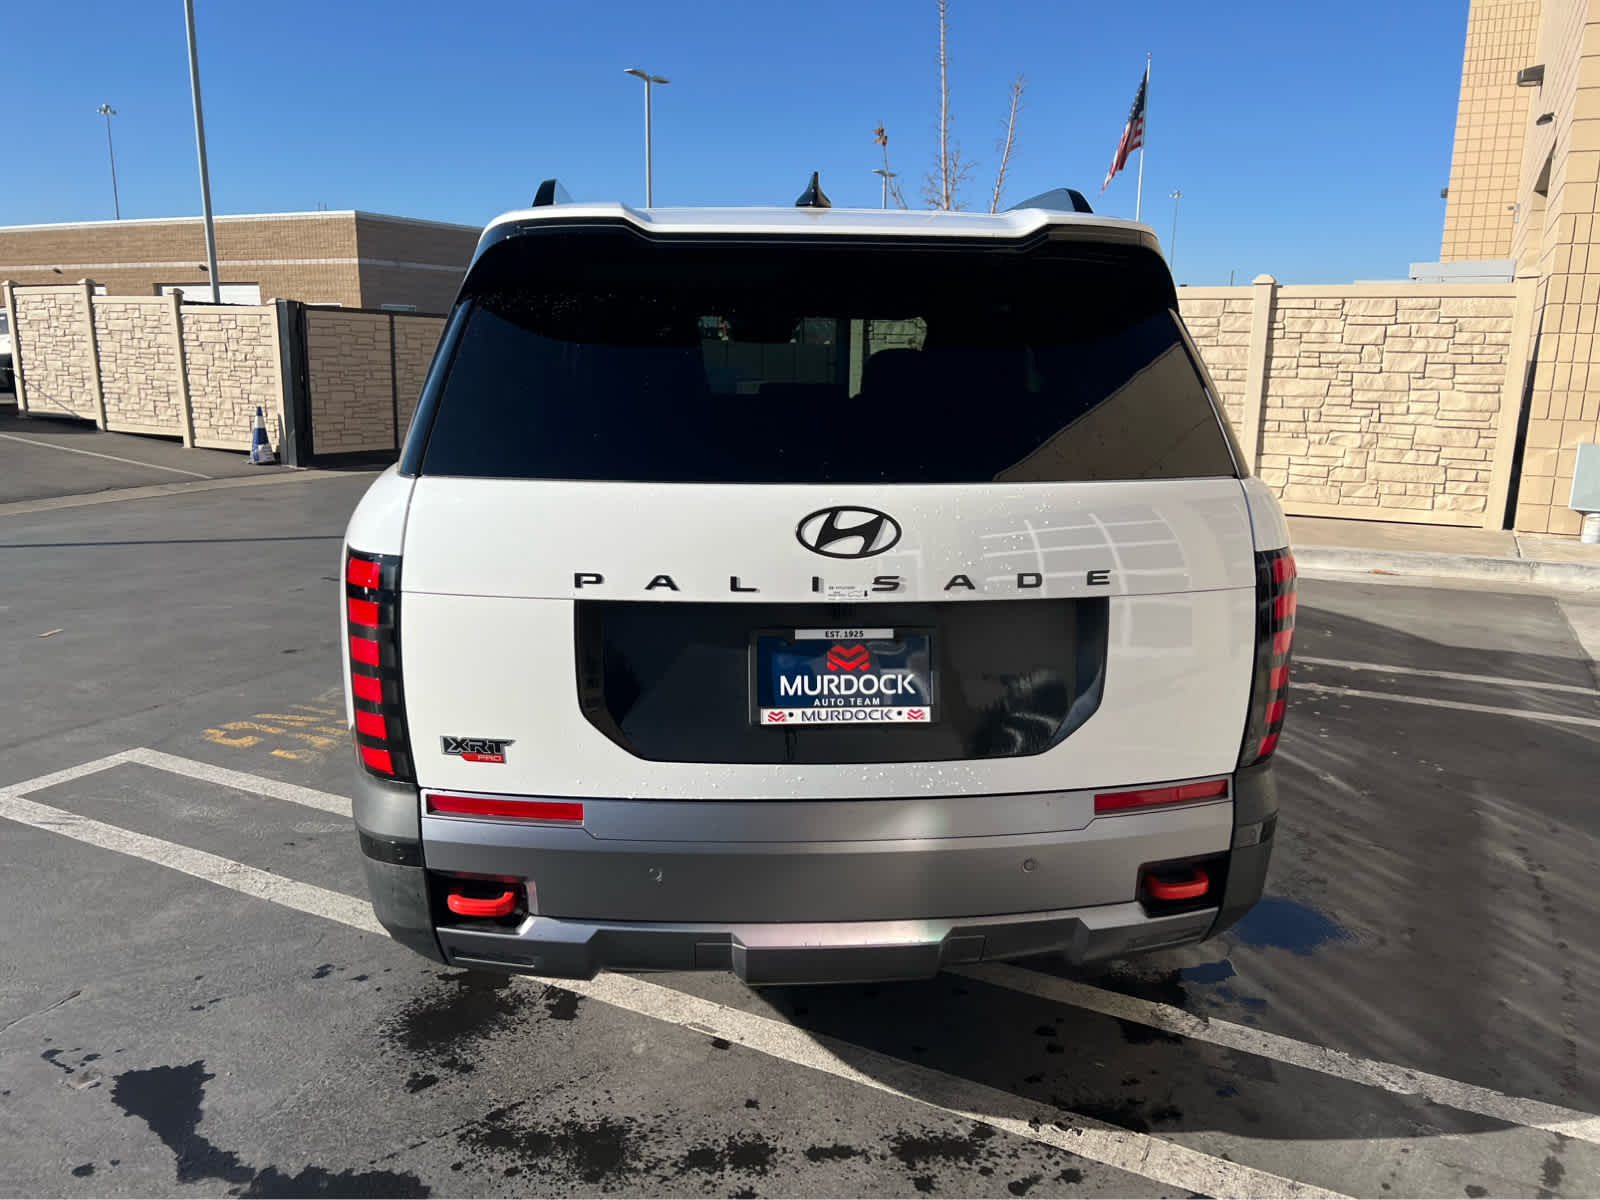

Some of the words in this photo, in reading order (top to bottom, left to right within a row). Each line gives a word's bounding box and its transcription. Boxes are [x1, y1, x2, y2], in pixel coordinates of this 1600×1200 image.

[573, 569, 1112, 593] PALISADE
[844, 630, 864, 638] 1925
[780, 674, 917, 697] MURDOCK
[813, 698, 845, 707] AUTO
[850, 697, 880, 706] TEAM
[801, 709, 894, 722] MURDOCK
[440, 736, 516, 755] XRT
[477, 754, 503, 762] PRO
